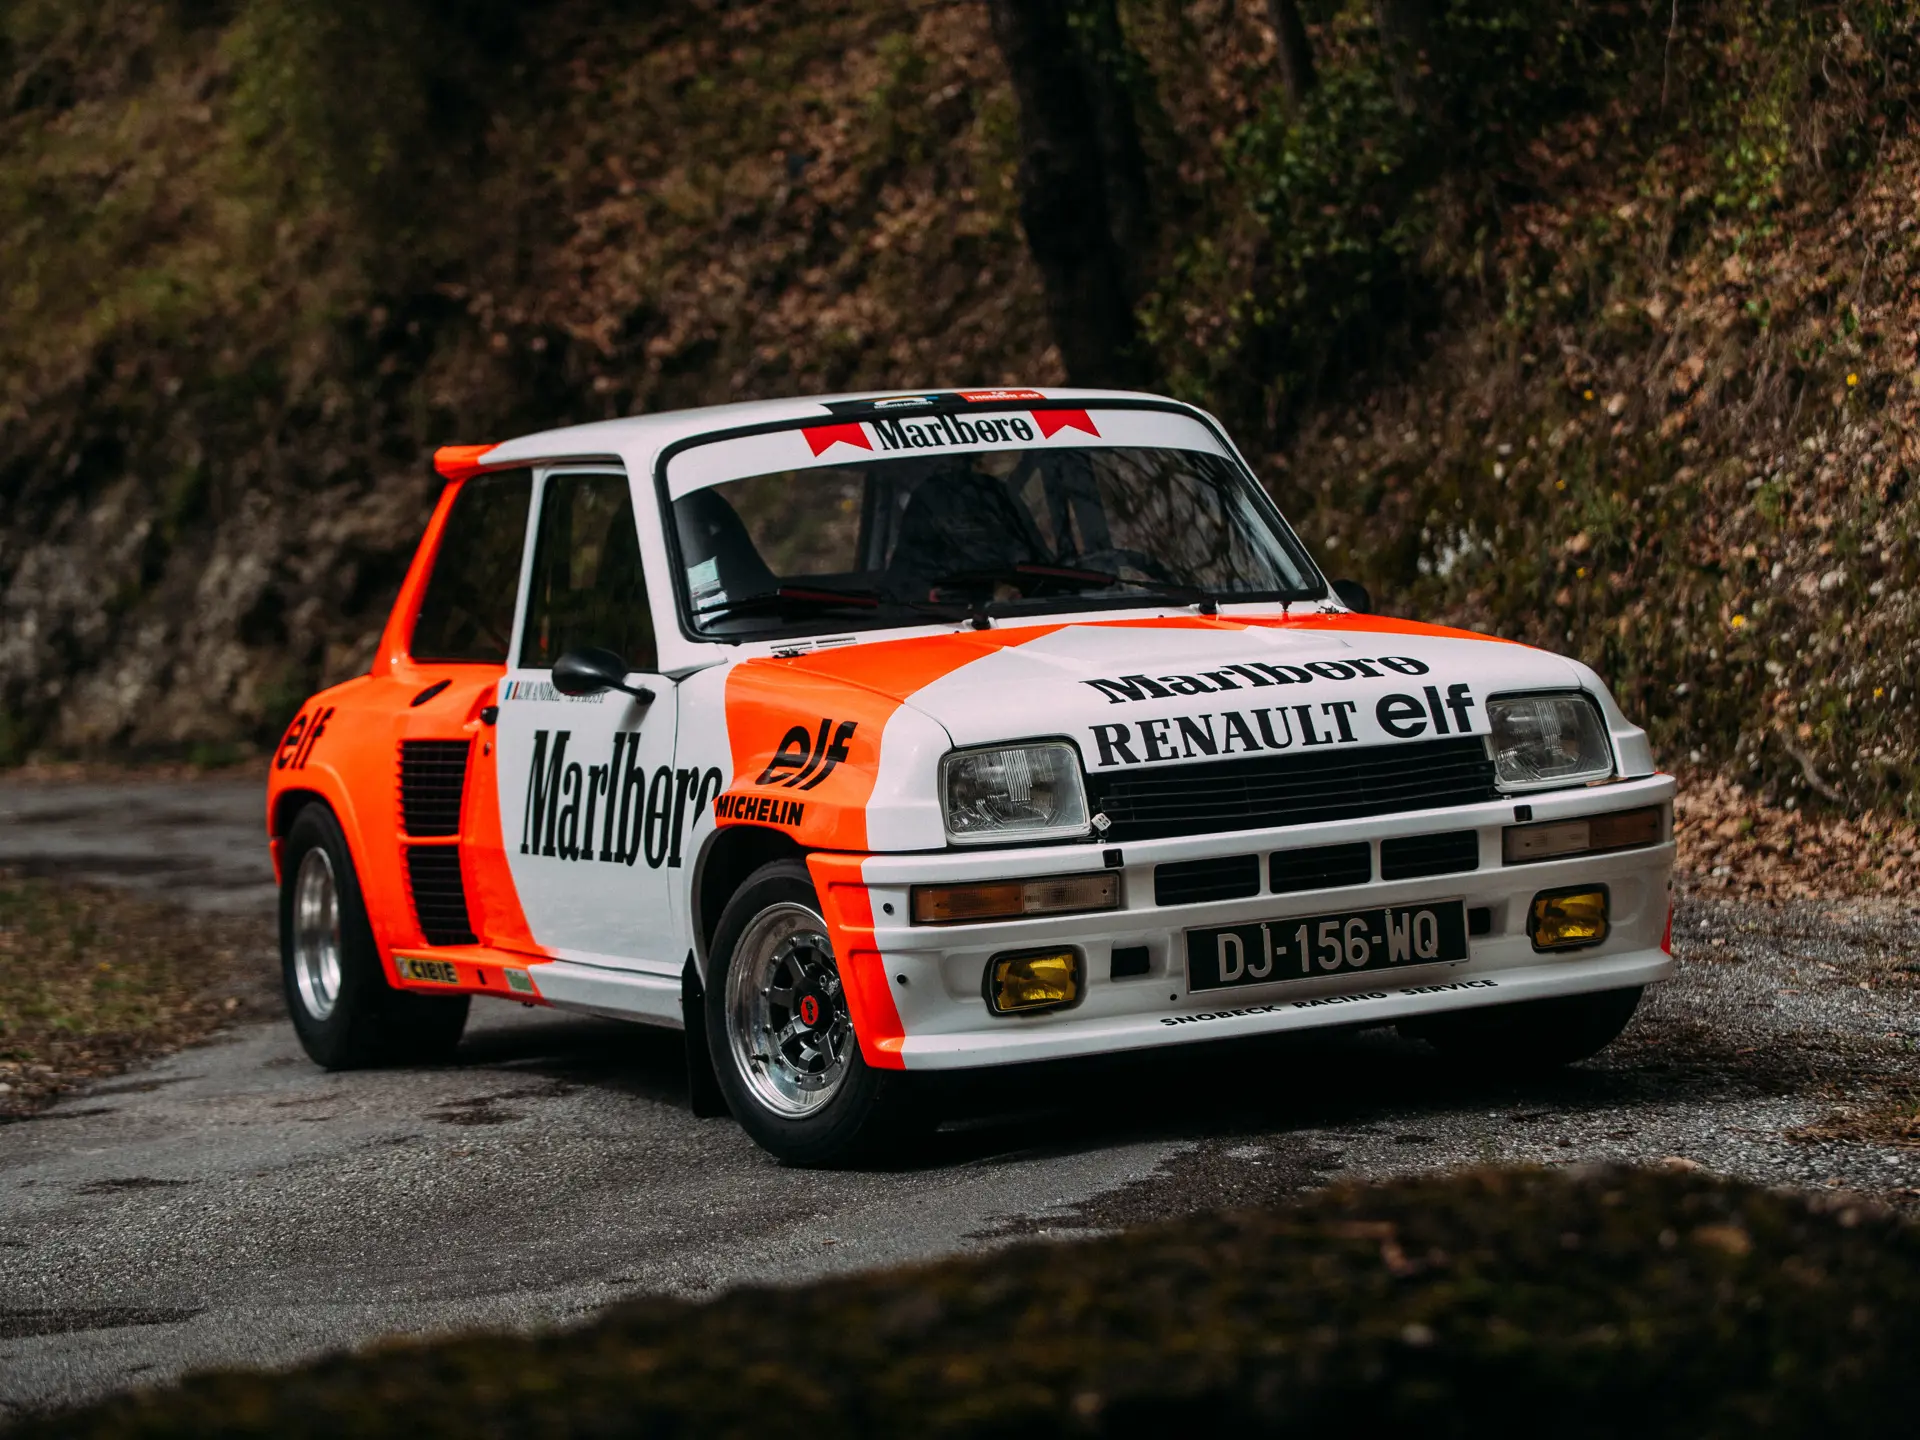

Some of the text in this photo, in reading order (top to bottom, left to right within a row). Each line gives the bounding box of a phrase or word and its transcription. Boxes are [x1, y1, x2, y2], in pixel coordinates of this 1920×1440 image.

[870, 413, 1035, 450] Marlboro
[1078, 656, 1430, 704] Marlboro
[278, 707, 335, 770] elf
[1088, 683, 1475, 767] RENAULT elf
[755, 718, 859, 791] elf
[715, 795, 805, 826] MICHELIN
[1217, 910, 1439, 982] DJ-156-WQ
[1160, 979, 1499, 1026] SNOBECK RACING SERVICE
